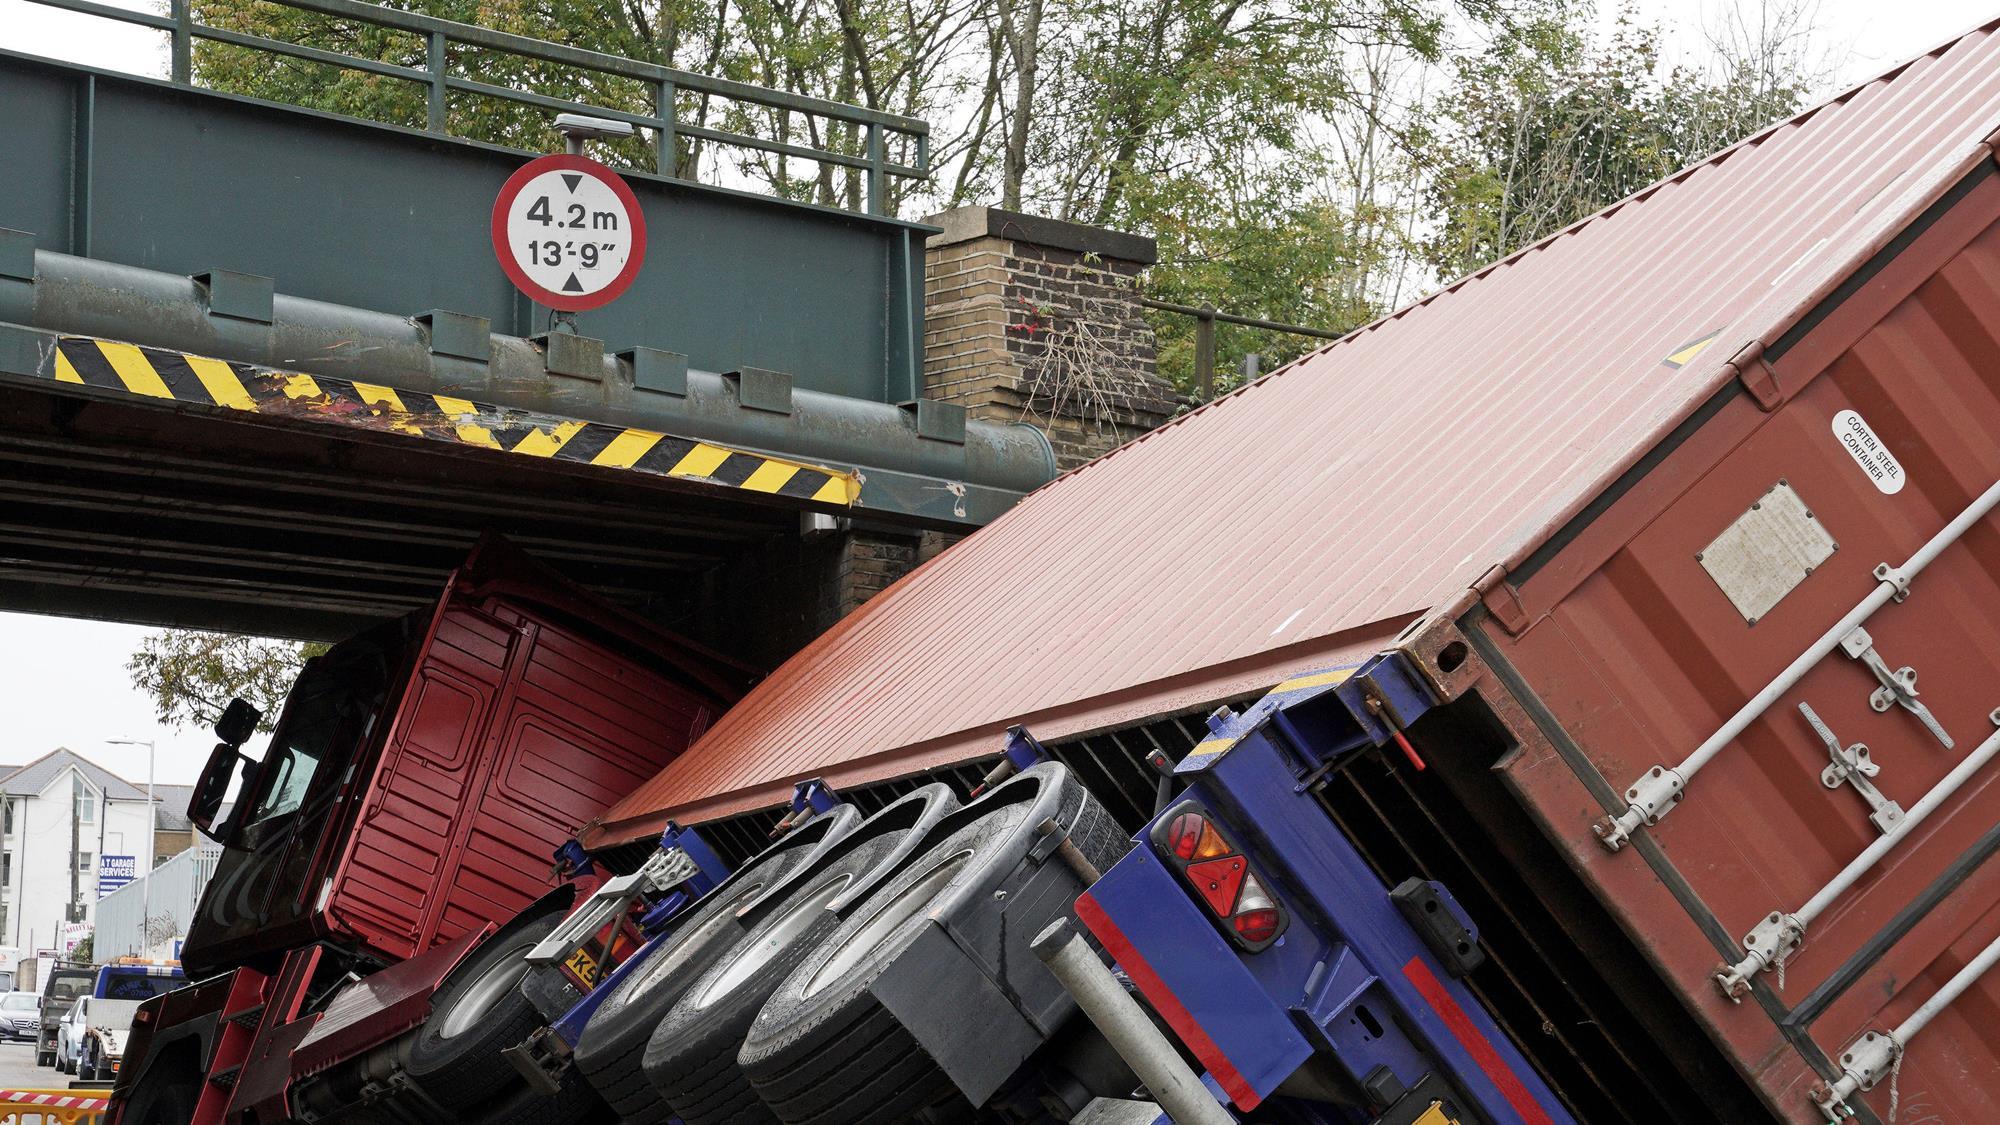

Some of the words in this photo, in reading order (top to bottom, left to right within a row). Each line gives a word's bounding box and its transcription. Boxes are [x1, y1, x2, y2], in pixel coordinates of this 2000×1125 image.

[1843, 432, 1884, 481] CONTAINER
[1847, 416, 1878, 452] CORTEN
[1875, 451, 1899, 480] STEEL
[99, 867, 134, 877] SERVICES
[111, 858, 134, 868] GARAGE
